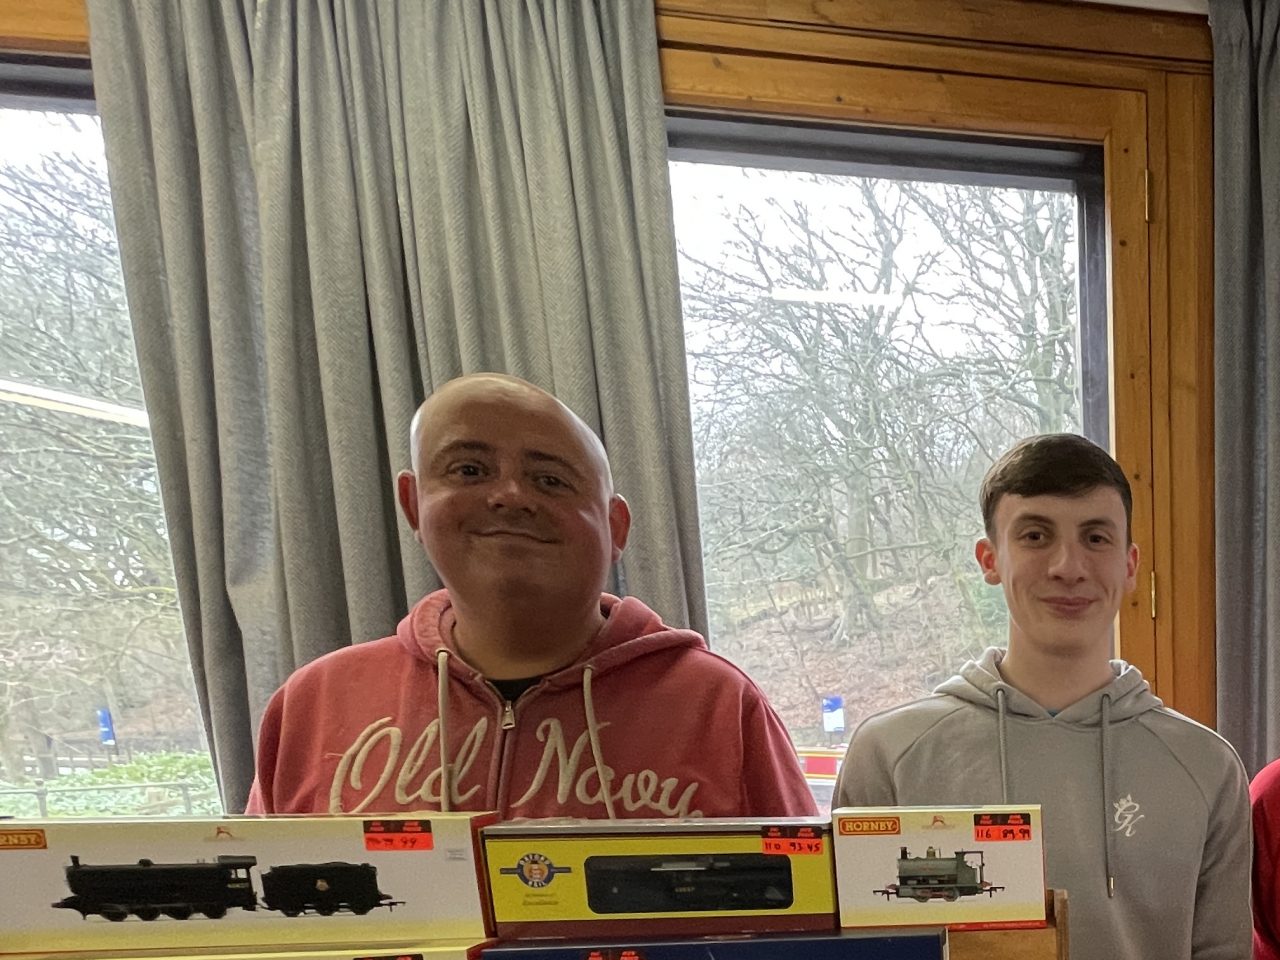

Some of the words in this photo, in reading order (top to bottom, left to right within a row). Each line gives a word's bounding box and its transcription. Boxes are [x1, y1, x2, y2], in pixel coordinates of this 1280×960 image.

[329, 716, 488, 814] Old
[510, 718, 703, 818] Navy
[845, 818, 895, 833] HORNBY
[976, 829, 992, 839] 116
